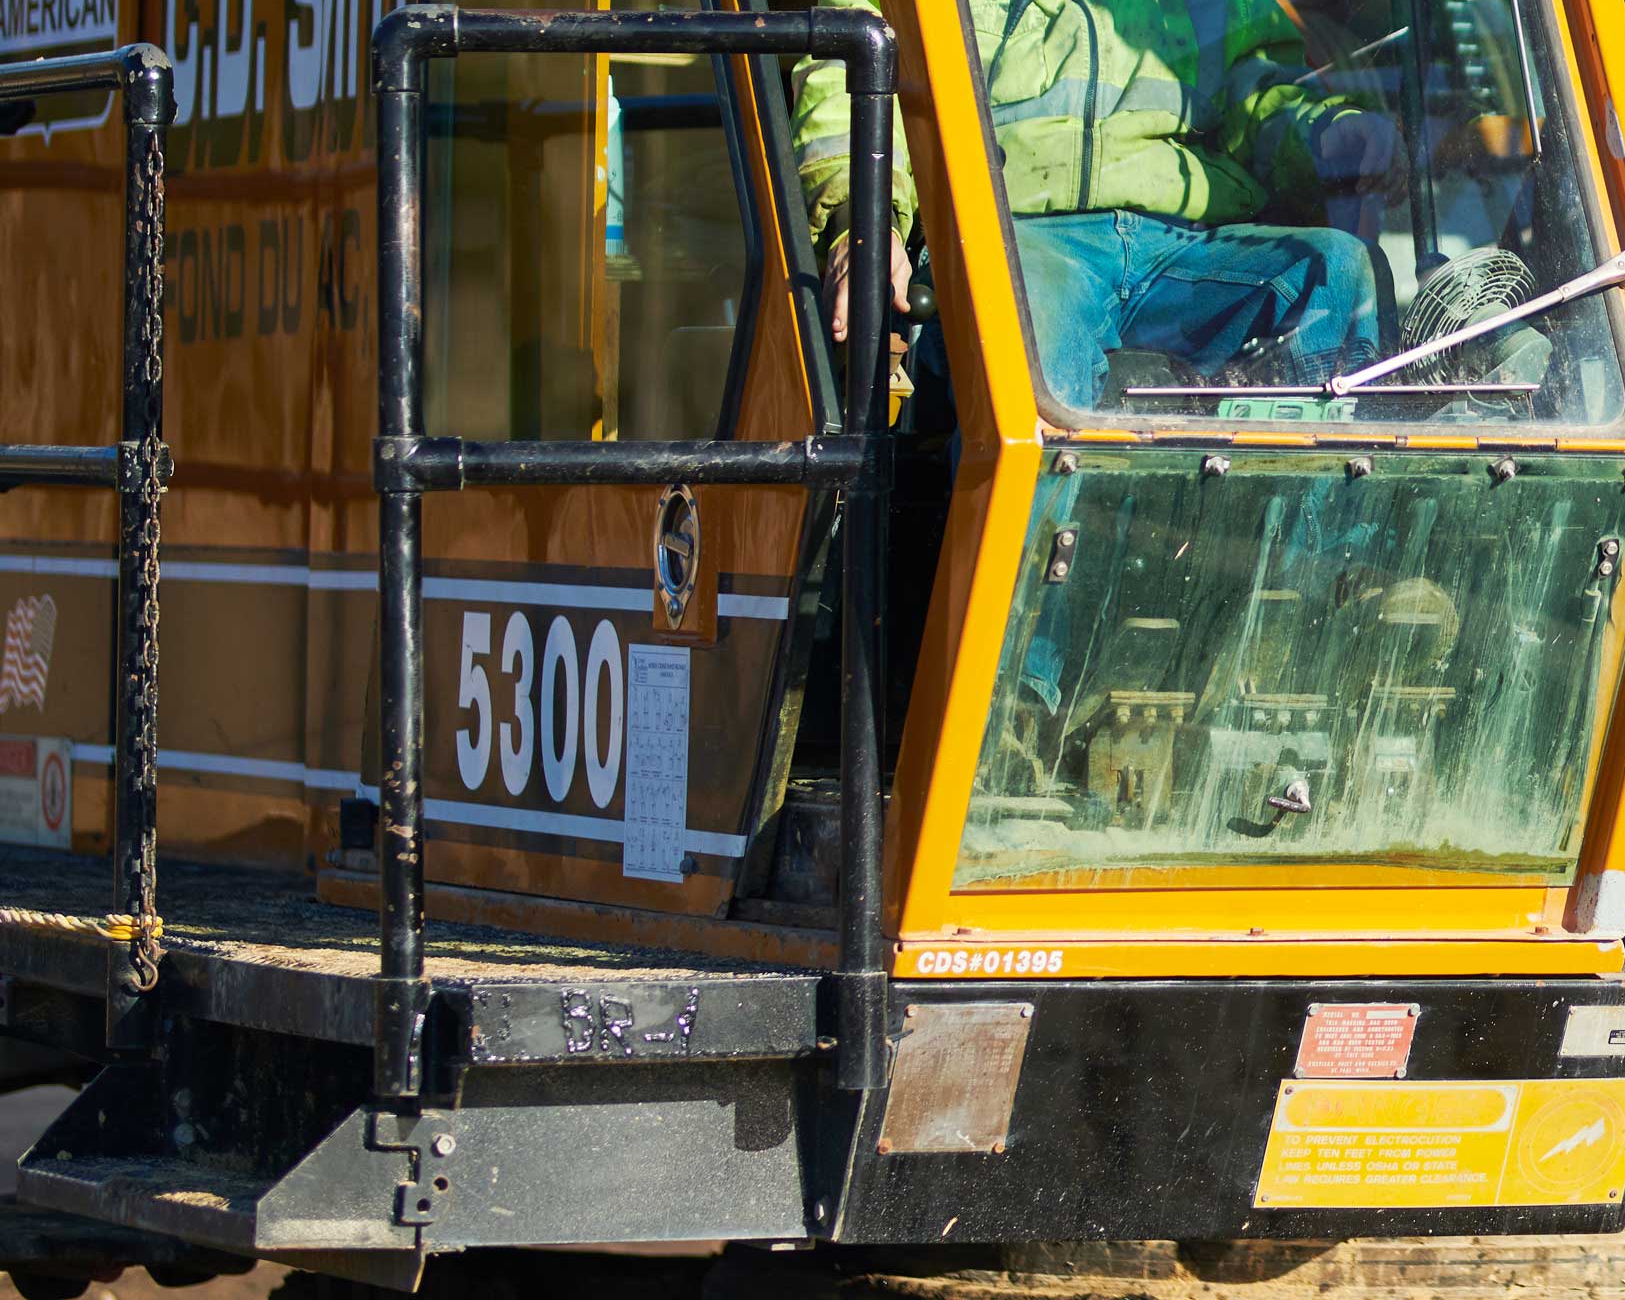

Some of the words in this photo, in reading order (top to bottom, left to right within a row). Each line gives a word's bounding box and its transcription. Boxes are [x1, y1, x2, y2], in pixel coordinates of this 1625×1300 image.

[258, 219, 304, 337] DU
[455, 610, 624, 809] 5300
[917, 950, 1063, 974] CDS#01395
[1284, 1135, 1300, 1144] TO
[1306, 1135, 1358, 1144] PREVENT
[1364, 1135, 1461, 1144] ELECTROCUTION
[1281, 1148, 1311, 1158] KEEP
[1317, 1148, 1340, 1158] TEN
[1344, 1148, 1373, 1158] FEET
[1378, 1148, 1411, 1158] FROM
[1416, 1148, 1457, 1158] POWER
[1278, 1161, 1310, 1171] LINES
[1316, 1161, 1361, 1171] UNLESS
[1366, 1161, 1399, 1171] OSHA
[1403, 1161, 1420, 1171] OR
[1423, 1161, 1458, 1171] STATE
[1303, 1174, 1361, 1184] REQUIRES
[1365, 1174, 1417, 1184] GREATER
